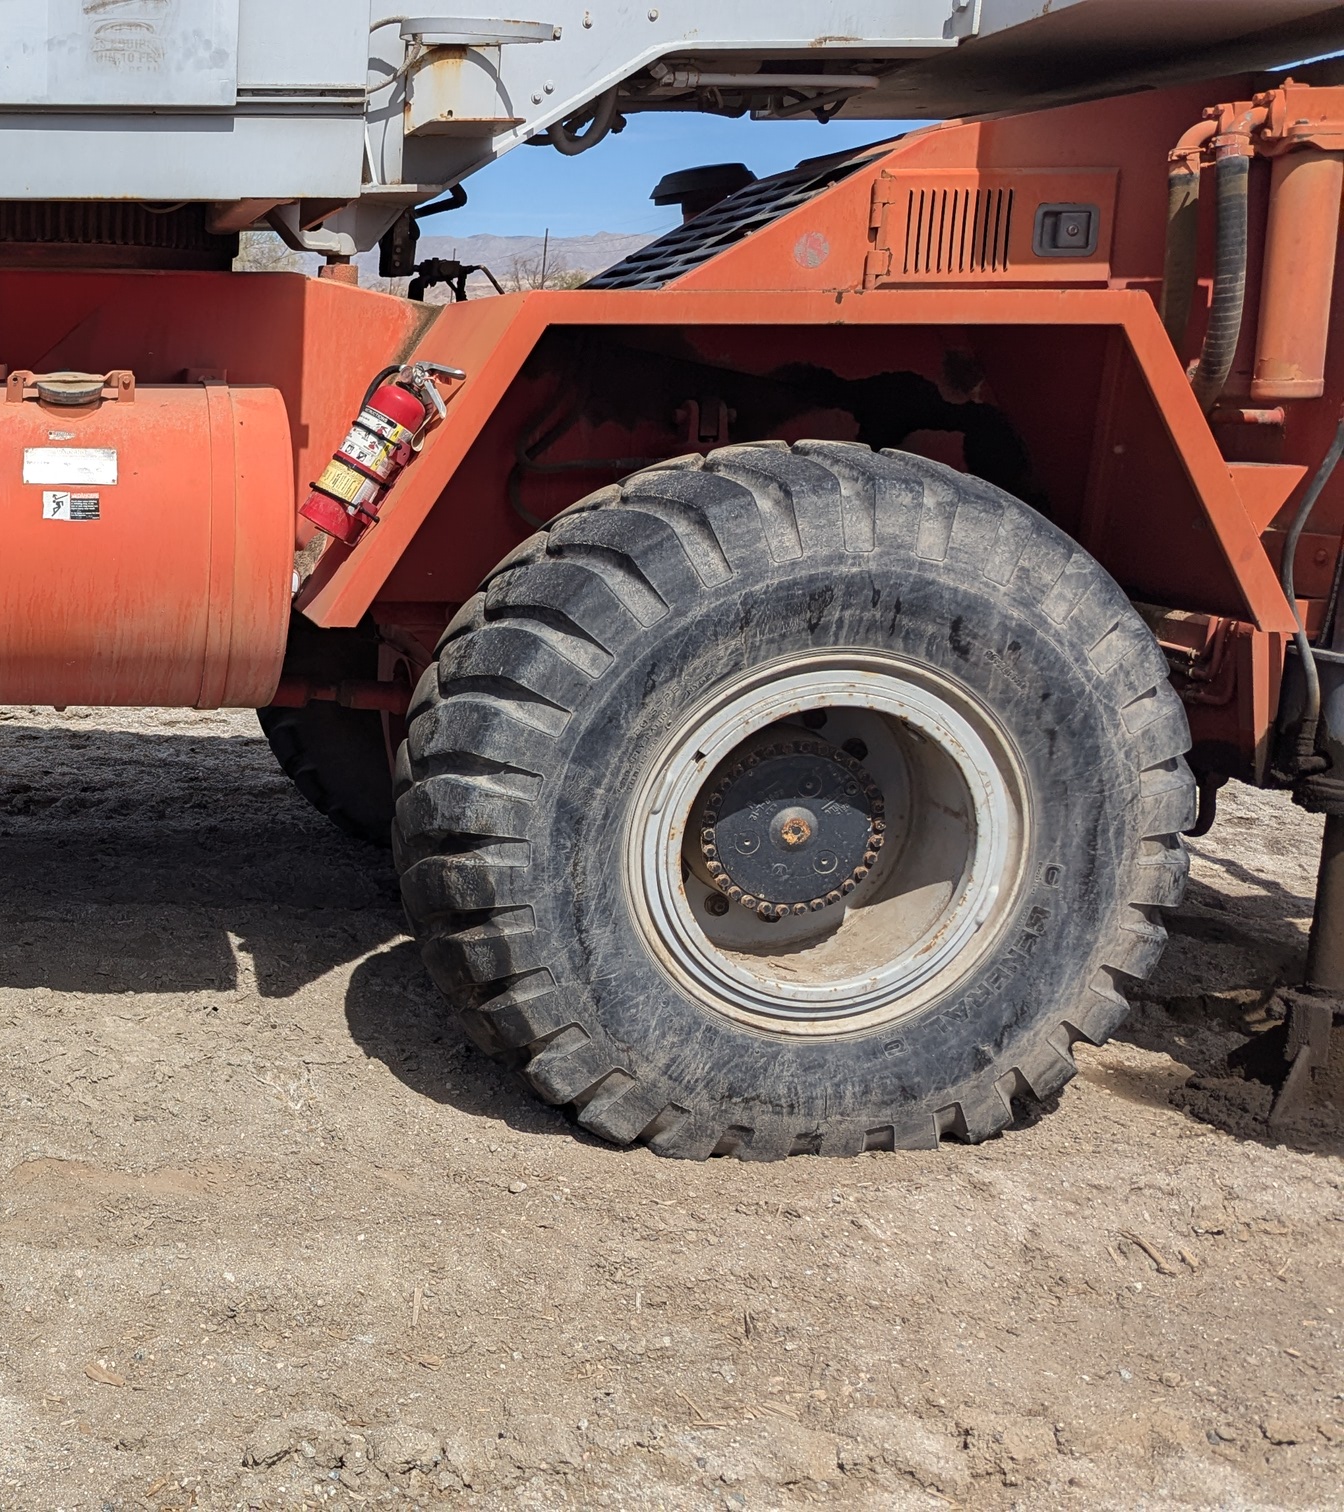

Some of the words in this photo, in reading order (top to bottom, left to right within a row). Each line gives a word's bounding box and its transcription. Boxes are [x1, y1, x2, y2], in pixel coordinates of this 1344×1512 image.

[393, 429, 399, 437] A
[374, 459, 380, 467] C
[921, 905, 1051, 1033] GENERAL
